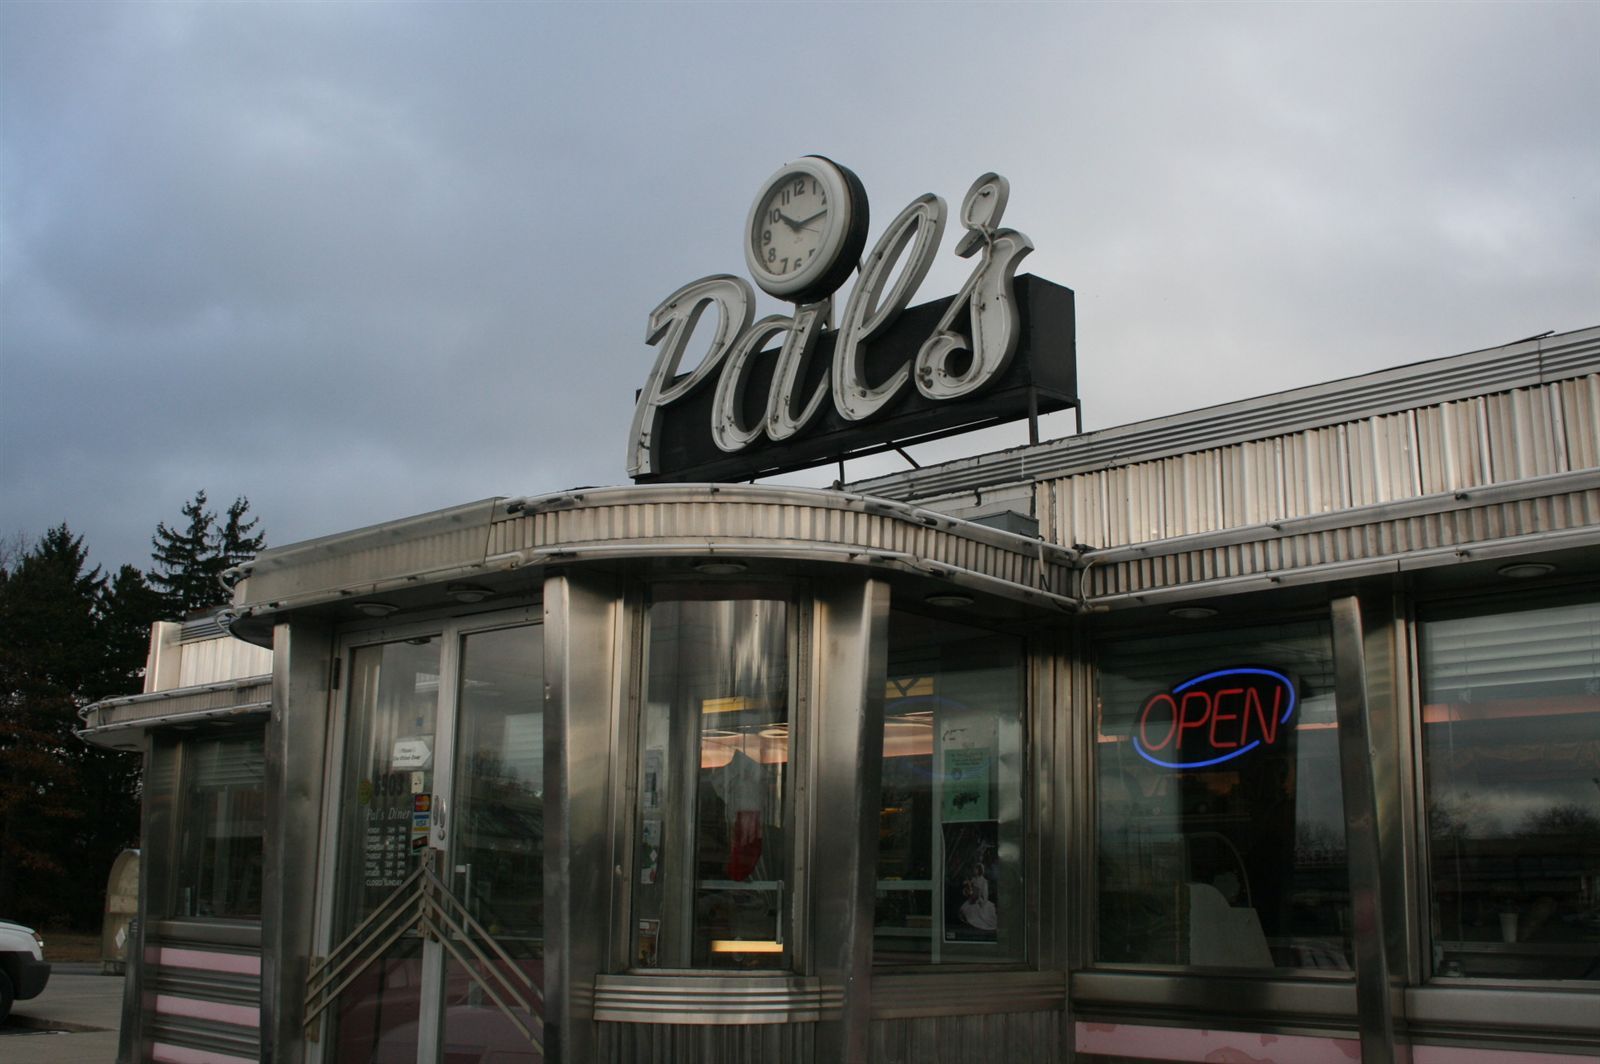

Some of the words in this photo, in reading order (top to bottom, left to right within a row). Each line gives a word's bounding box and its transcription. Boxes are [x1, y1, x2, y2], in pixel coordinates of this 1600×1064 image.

[794, 181, 805, 197] 12
[782, 190, 790, 206] 11
[769, 209, 781, 225] 10
[764, 231, 772, 246] 9
[768, 248, 776, 263] 8
[781, 258, 789, 274] 7
[627, 172, 1035, 480] Pal's
[1140, 686, 1281, 750] OPEN
[387, 807, 411, 821] Diner
